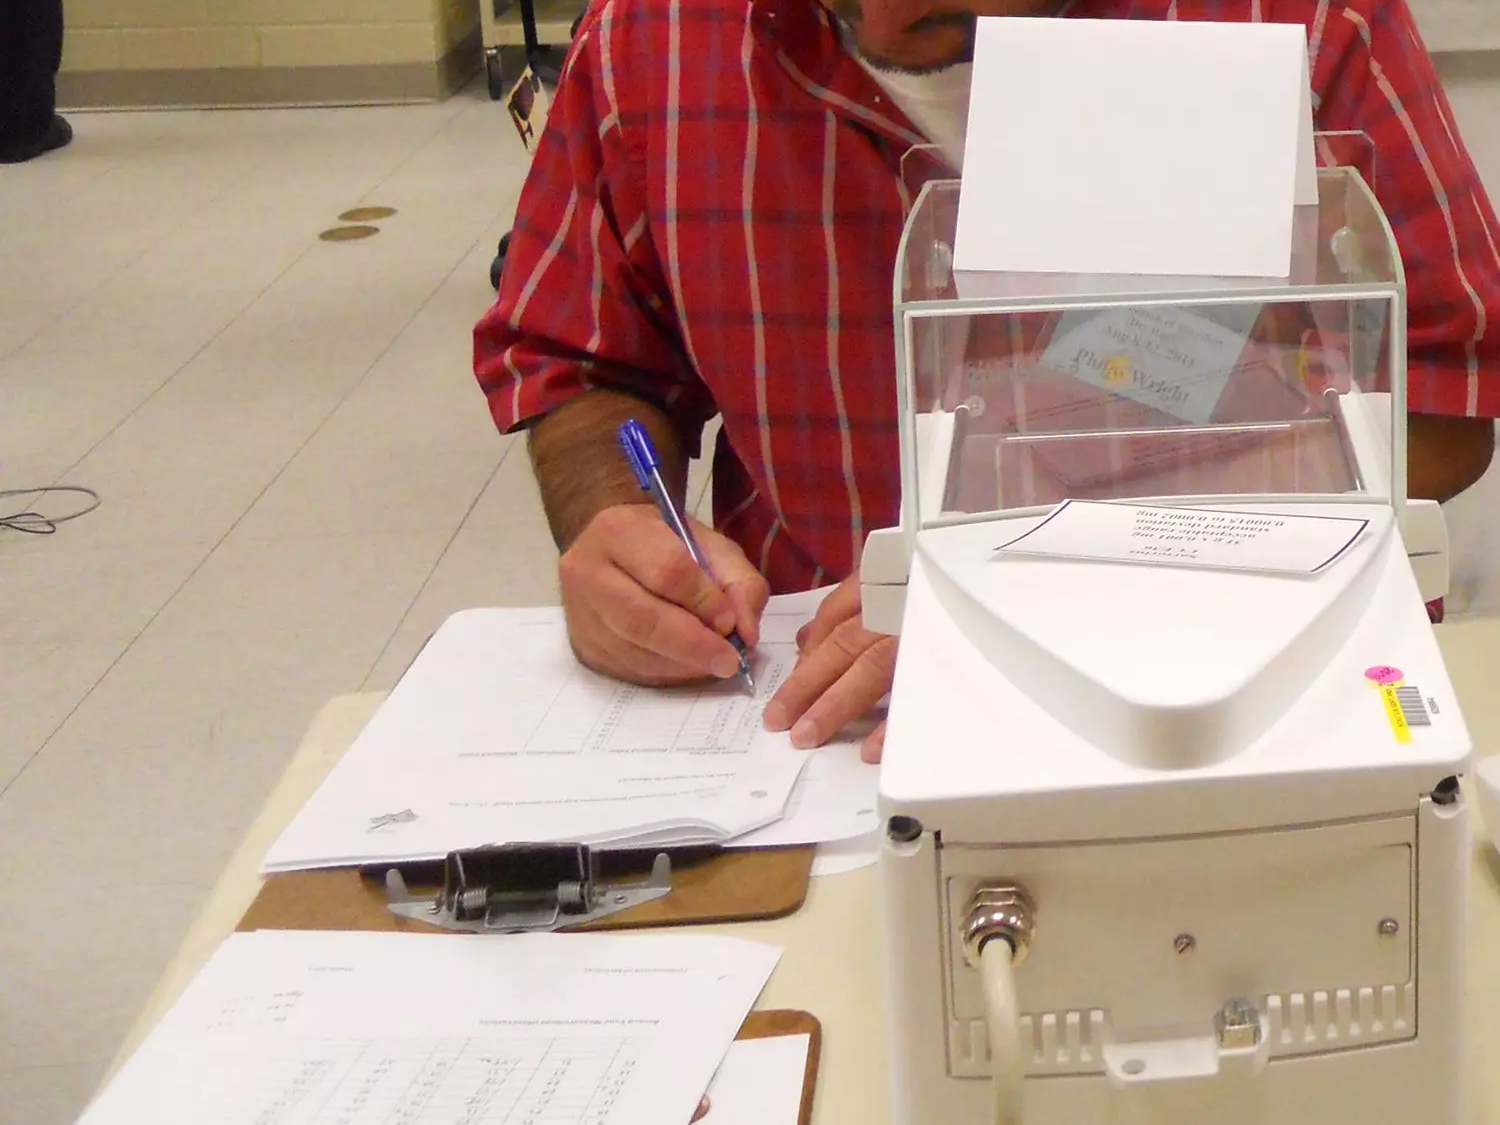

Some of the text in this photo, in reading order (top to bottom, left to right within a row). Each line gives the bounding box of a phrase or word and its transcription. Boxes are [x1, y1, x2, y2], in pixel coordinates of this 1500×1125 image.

[1133, 368, 1190, 404] Wright
[1161, 513, 1208, 522] 0.0002
[1229, 518, 1285, 527] 0.00015
[1136, 519, 1269, 532] standard deviation
[1178, 528, 1256, 539] acceptable
